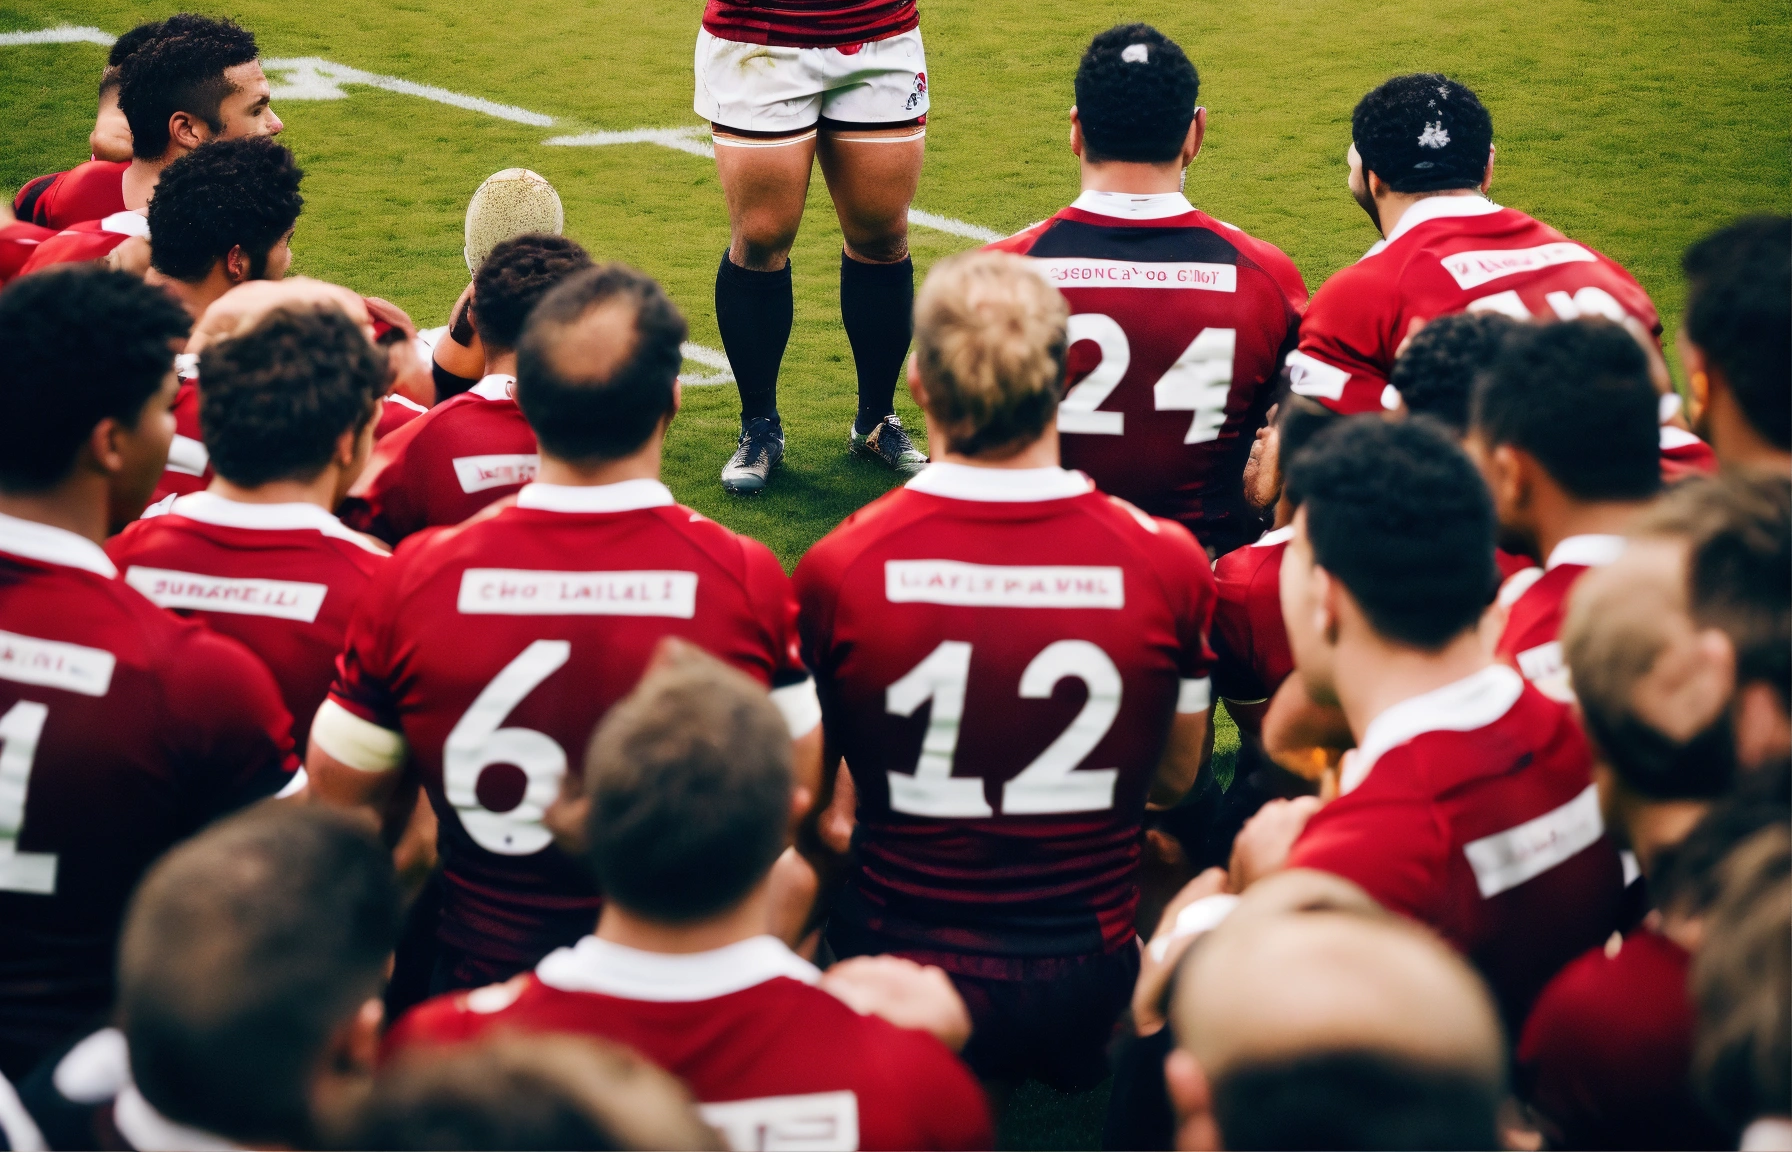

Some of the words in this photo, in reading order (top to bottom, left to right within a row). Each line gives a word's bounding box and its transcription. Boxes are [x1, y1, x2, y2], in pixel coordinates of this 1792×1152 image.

[1056, 313, 1236, 444] 24
[442, 639, 571, 855] 6
[885, 639, 1124, 817] 12
